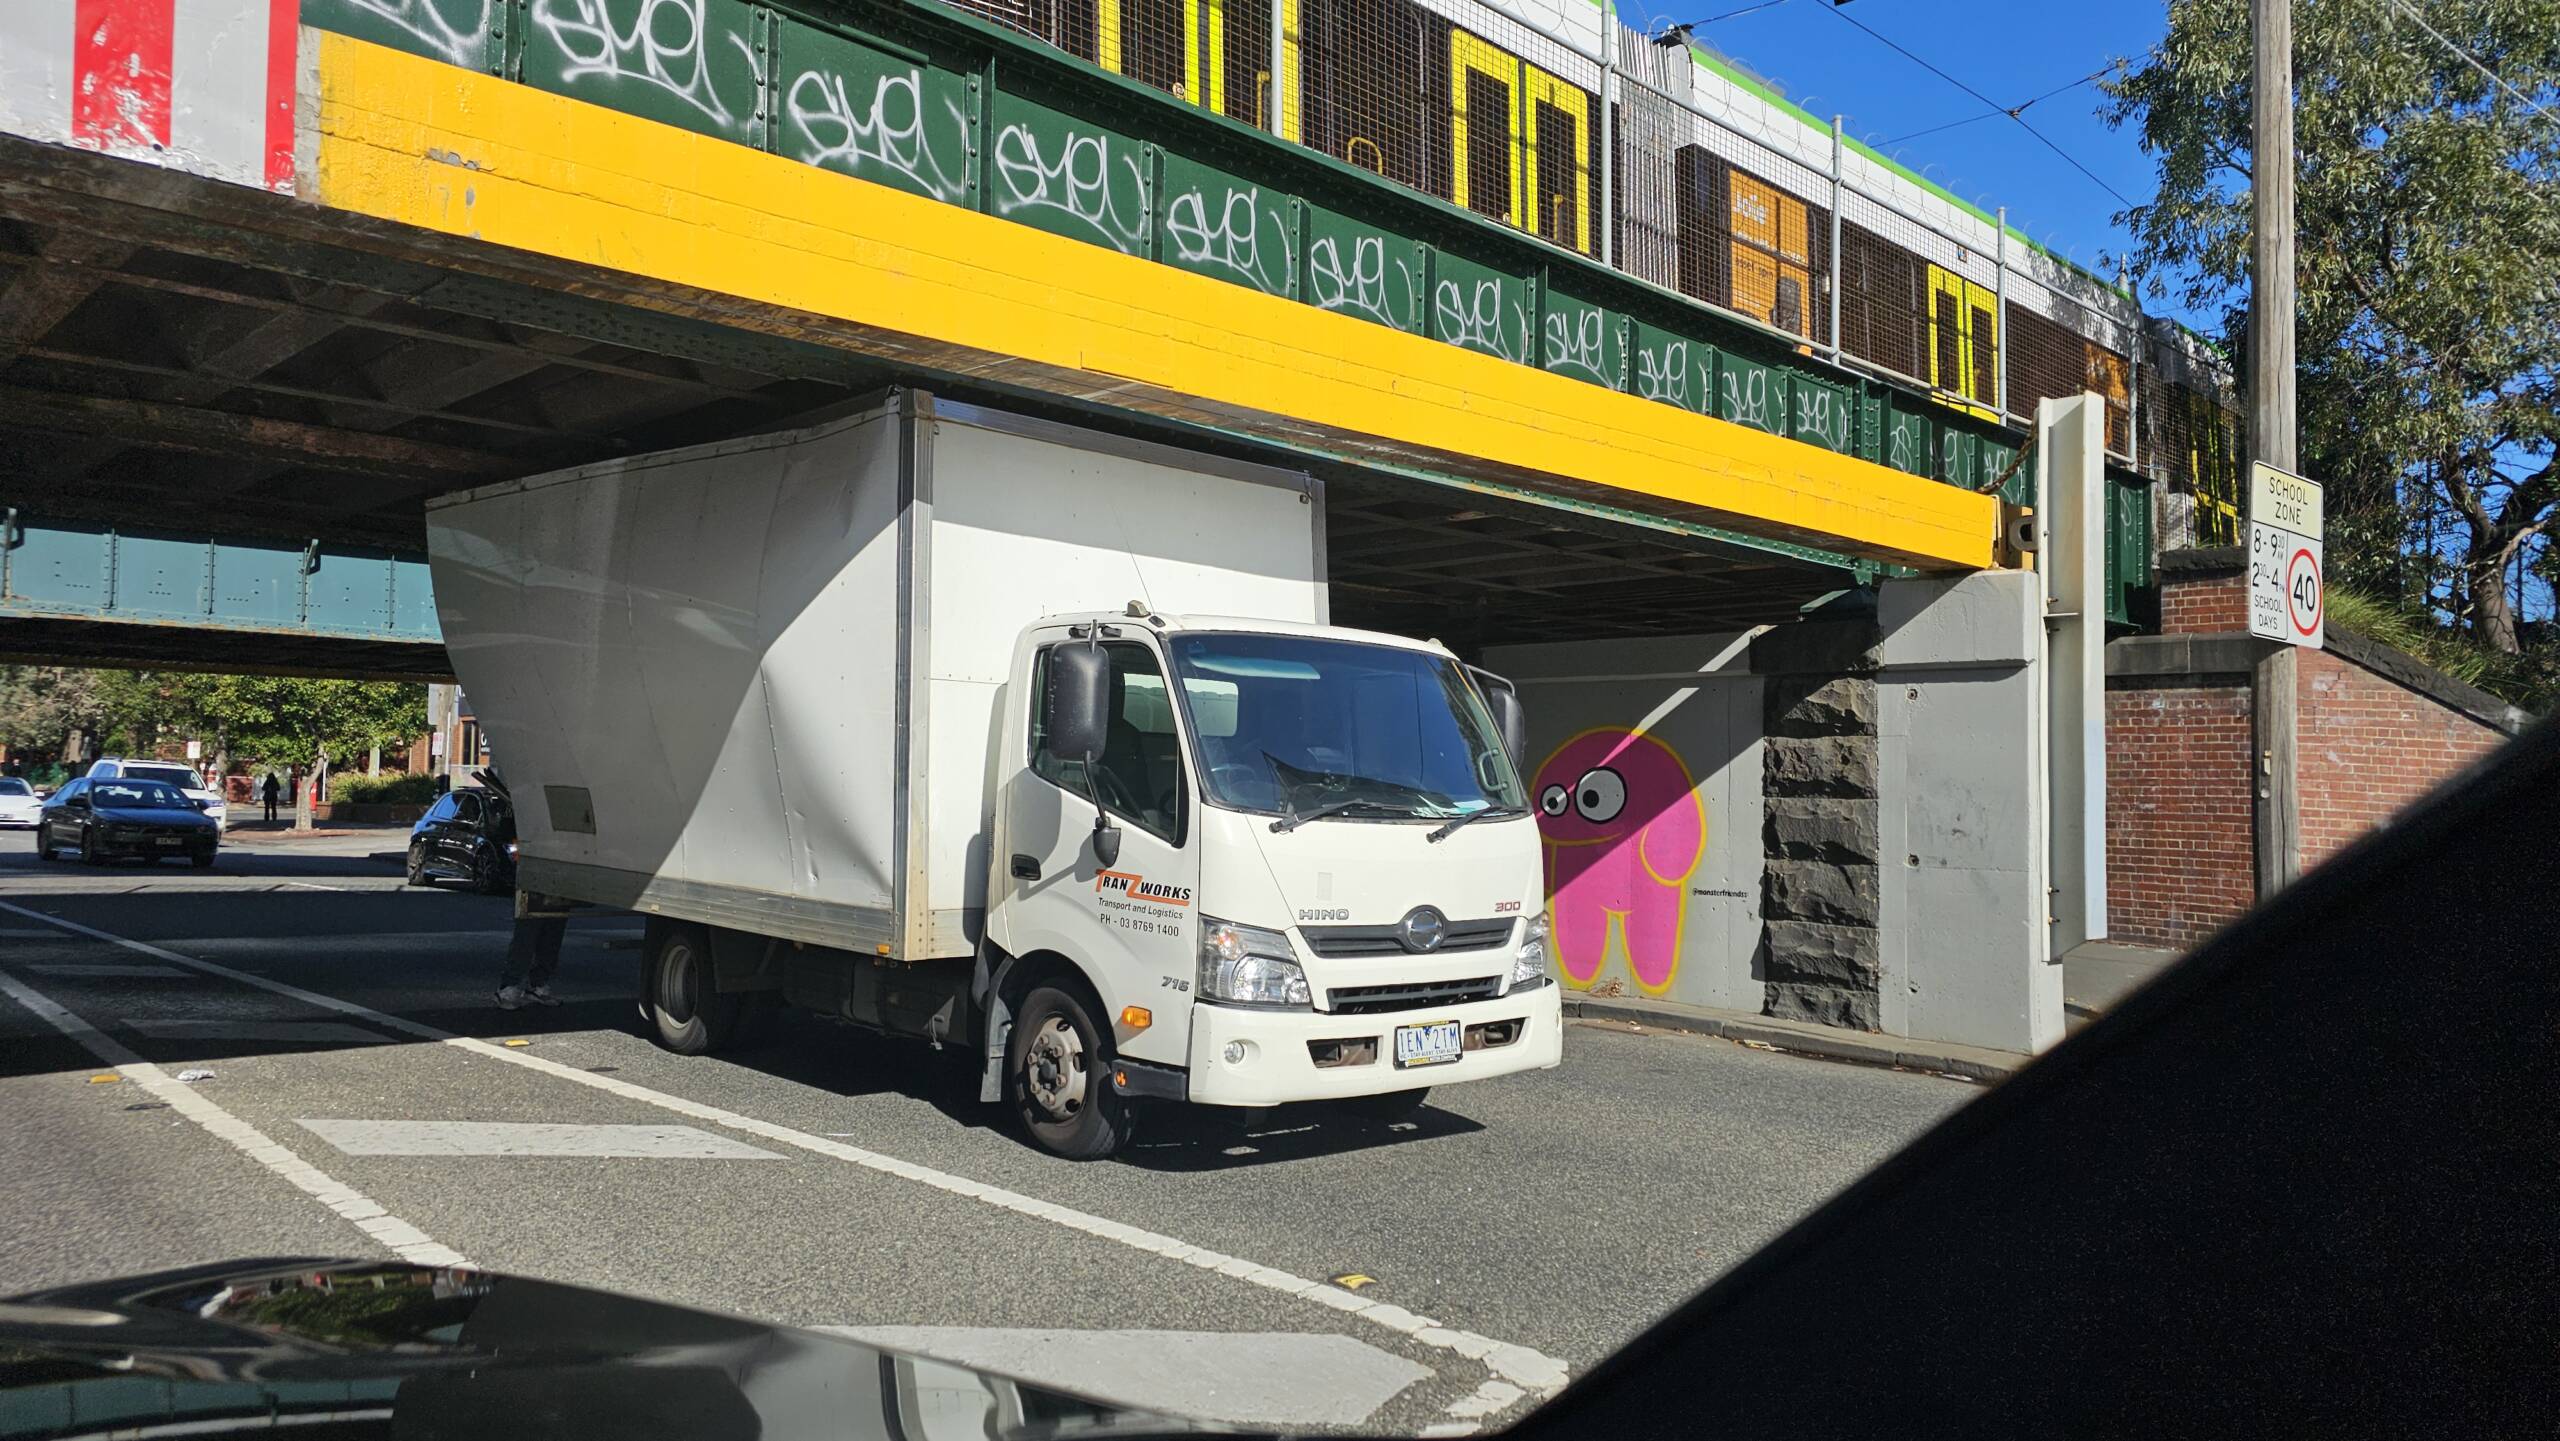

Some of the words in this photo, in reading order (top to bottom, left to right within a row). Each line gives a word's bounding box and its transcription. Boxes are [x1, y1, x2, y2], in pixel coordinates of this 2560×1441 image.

[2269, 476, 2308, 505] SCHOOL
[2275, 501, 2302, 525] ZONE
[2254, 594, 2283, 613] SCHOOL
[2293, 573, 2316, 612] 40
[2258, 613, 2278, 631] DAYS
[1098, 897, 1131, 911] Transport
[1132, 904, 1146, 914] and
[1148, 905, 1183, 920] Logistics
[1299, 908, 1350, 921] HINO
[1494, 901, 1521, 912] 300
[1100, 913, 1111, 925] PH
[1120, 917, 1130, 928] 03
[1132, 919, 1154, 933] 8769
[1157, 924, 1179, 937] 1400
[1161, 976, 1190, 992] 716
[1433, 1027, 1458, 1050] 2TM
